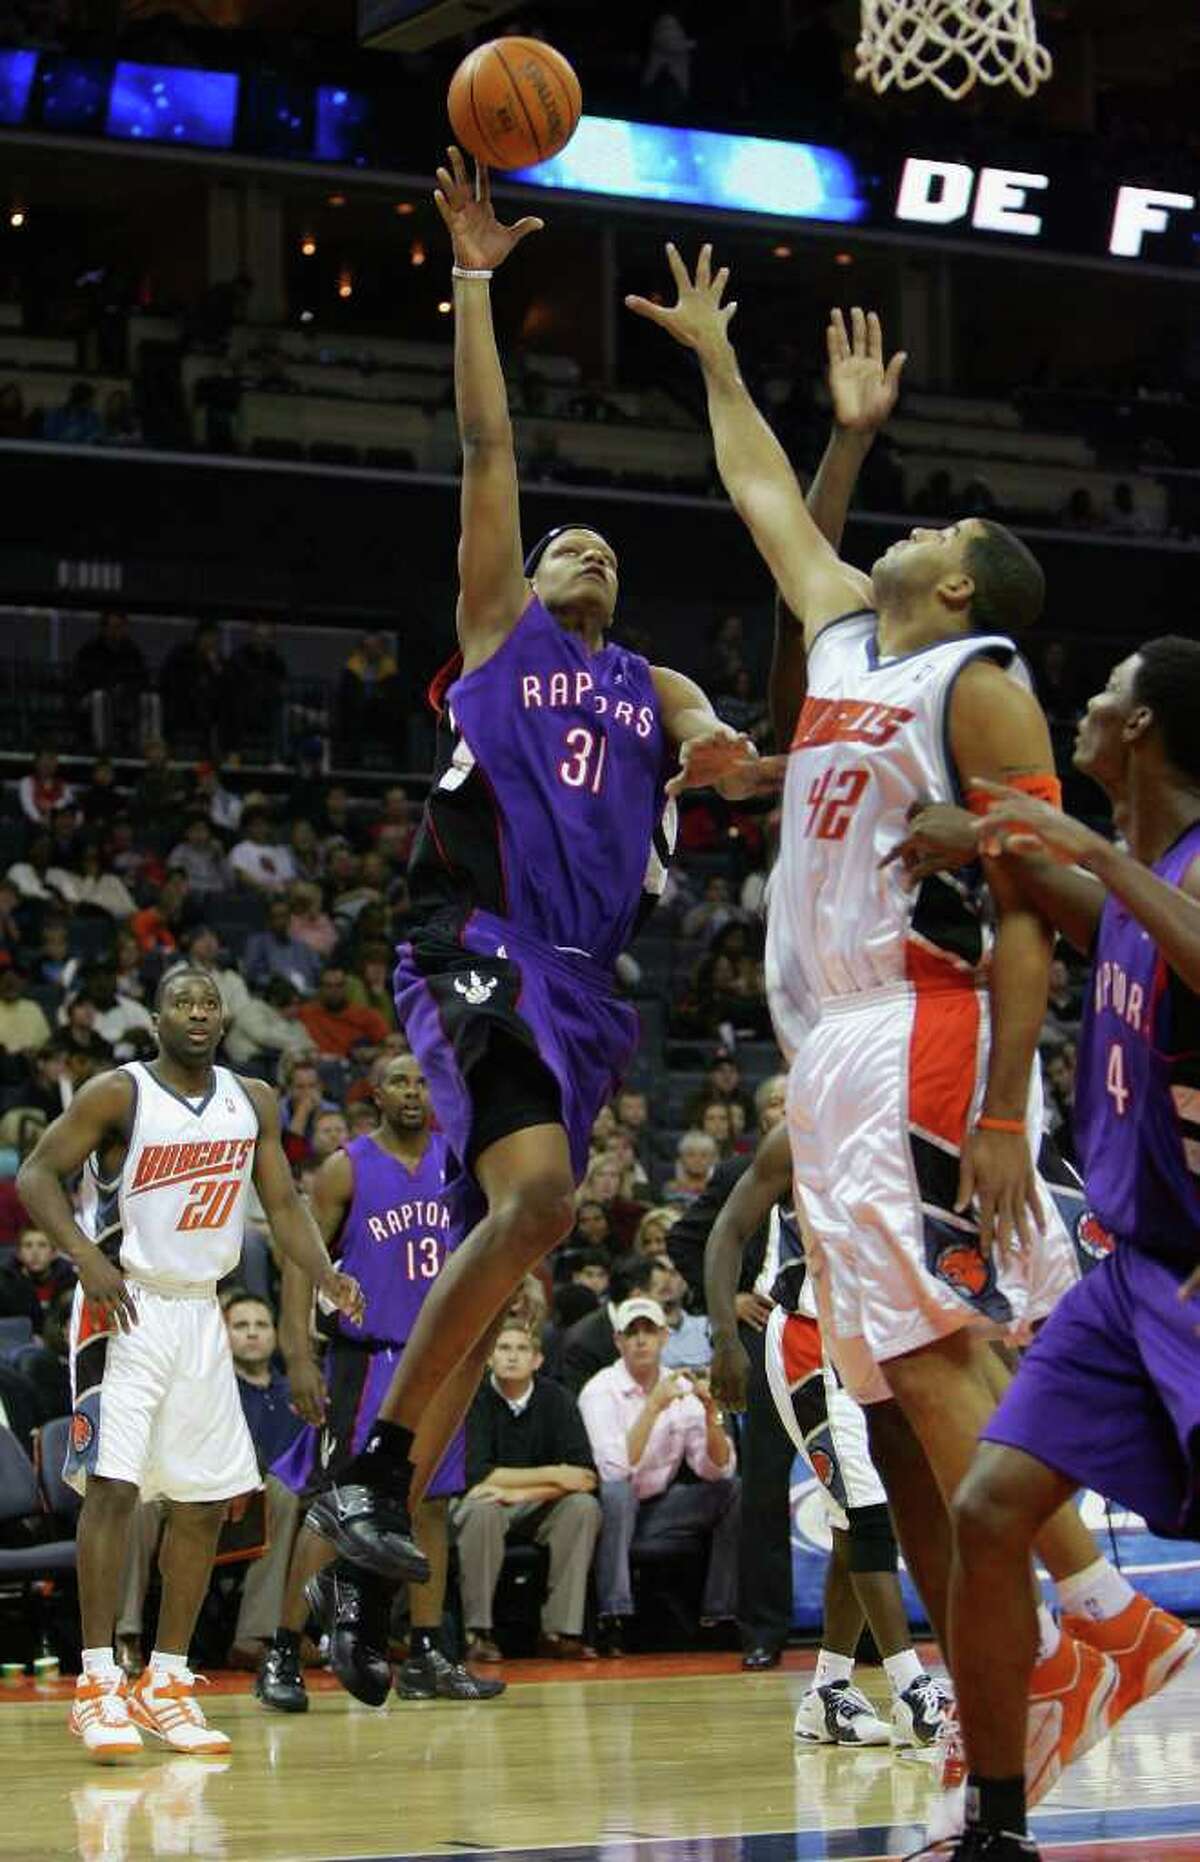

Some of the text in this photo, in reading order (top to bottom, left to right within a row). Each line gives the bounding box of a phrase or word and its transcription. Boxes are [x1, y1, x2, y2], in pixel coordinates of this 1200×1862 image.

[896, 157, 1195, 257] DE F
[523, 672, 654, 738] RAPORS
[561, 728, 608, 793] 31
[803, 767, 870, 841] 42
[1107, 1044, 1129, 1116] 4
[130, 1138, 257, 1190] BOBCATS
[176, 1180, 242, 1232] 20
[407, 1237, 440, 1281] 13
